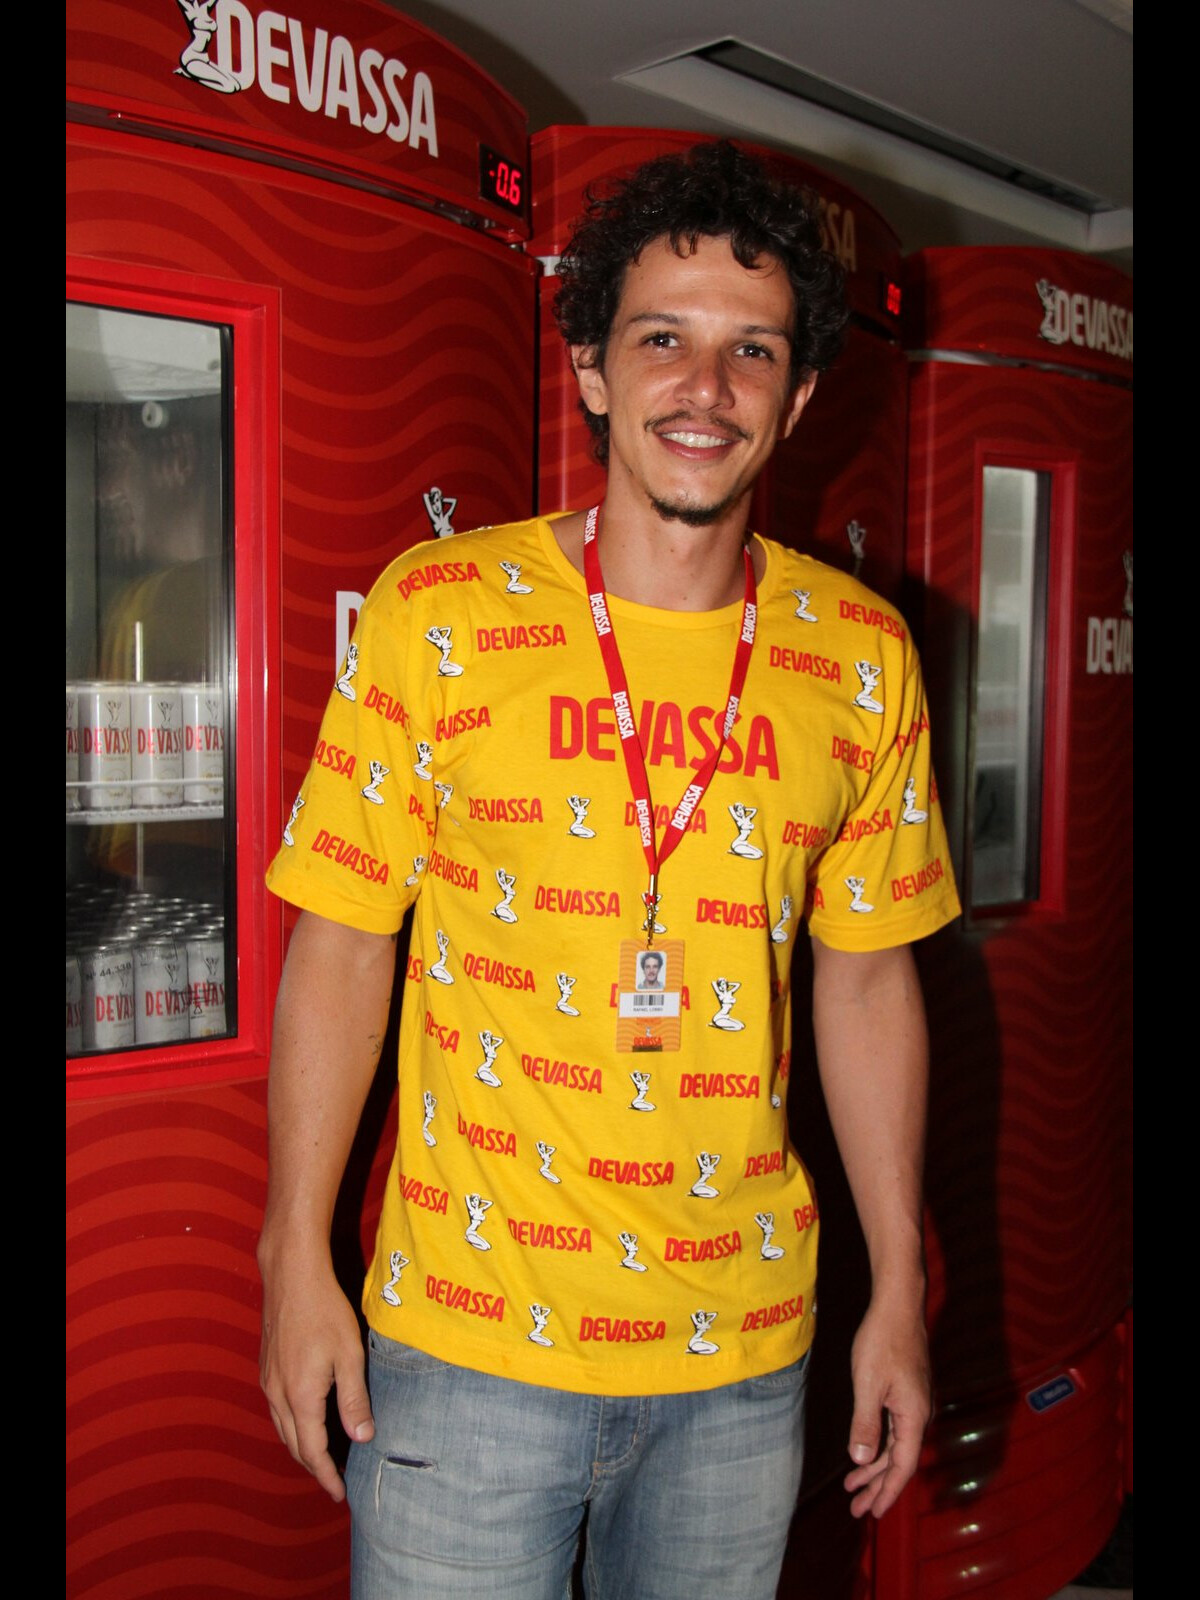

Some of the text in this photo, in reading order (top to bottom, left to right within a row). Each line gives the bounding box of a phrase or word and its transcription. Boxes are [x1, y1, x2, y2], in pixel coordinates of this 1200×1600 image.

[213, 0, 439, 158] DEVASSA
[397, 562, 482, 601] DEVASSA
[589, 592, 612, 637] DEVASSA
[741, 602, 757, 645] DEVASSA
[477, 624, 567, 653] DEVASSA
[770, 645, 841, 685] DEVASSA
[612, 691, 635, 739] DEVASSA
[469, 796, 543, 823] DEVASSA
[635, 798, 651, 847] DEVASSA
[671, 784, 704, 831] DEVASSA
[311, 829, 389, 885] DEVASSA
[428, 850, 478, 892] DEVASSA
[891, 858, 944, 902] DEVASSA
[535, 885, 620, 917] DEVASSA
[464, 953, 536, 992] DEVASSA
[521, 1054, 602, 1094] DEVASSA
[679, 1073, 760, 1099] DEVASSA
[588, 1157, 675, 1187] DEVASSA
[507, 1218, 592, 1253] DEVASSA
[664, 1230, 741, 1262] DEVASSA
[426, 1275, 506, 1322] DEVASSA
[741, 1295, 803, 1332] DEVASSA
[579, 1316, 666, 1343] DEVASSA
